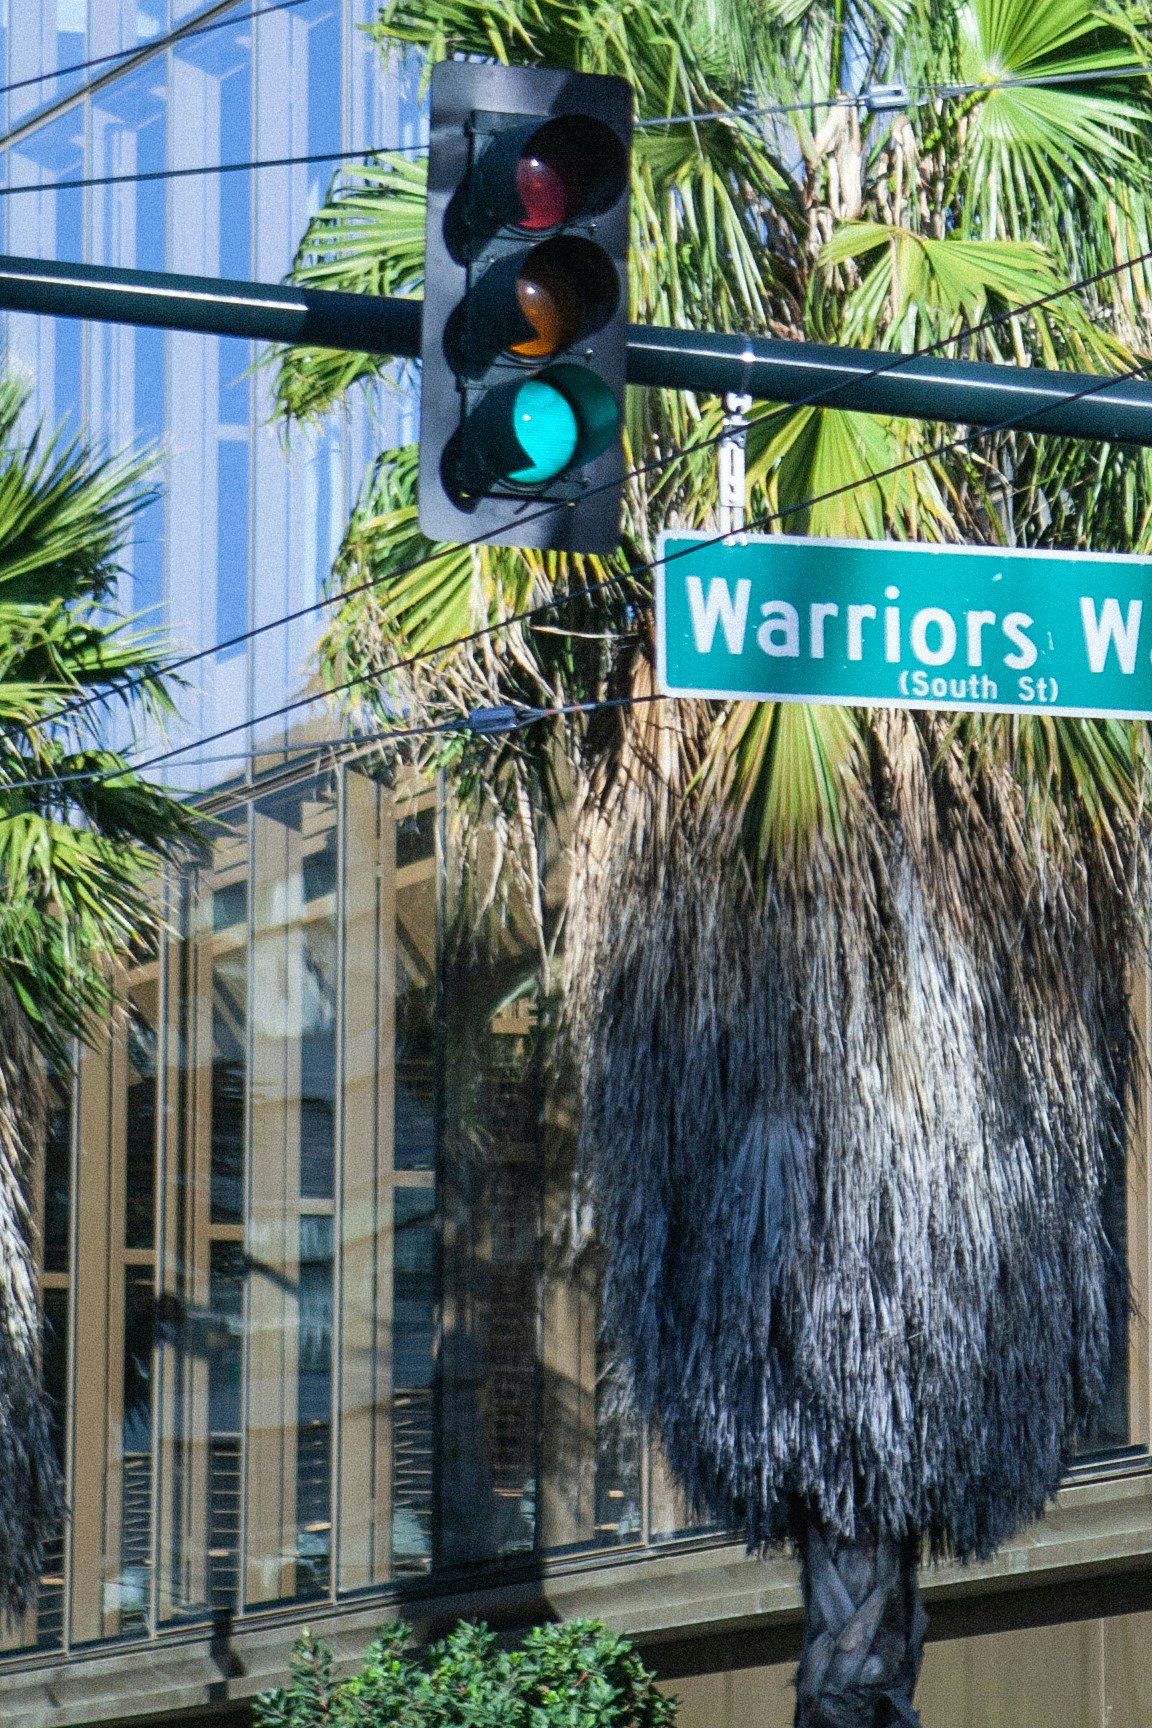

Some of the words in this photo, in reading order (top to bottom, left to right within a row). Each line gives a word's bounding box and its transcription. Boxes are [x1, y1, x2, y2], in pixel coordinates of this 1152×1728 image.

[685, 575, 1038, 671] Warriors
[899, 671, 998, 701] (South
[1018, 676, 1059, 704] St)
